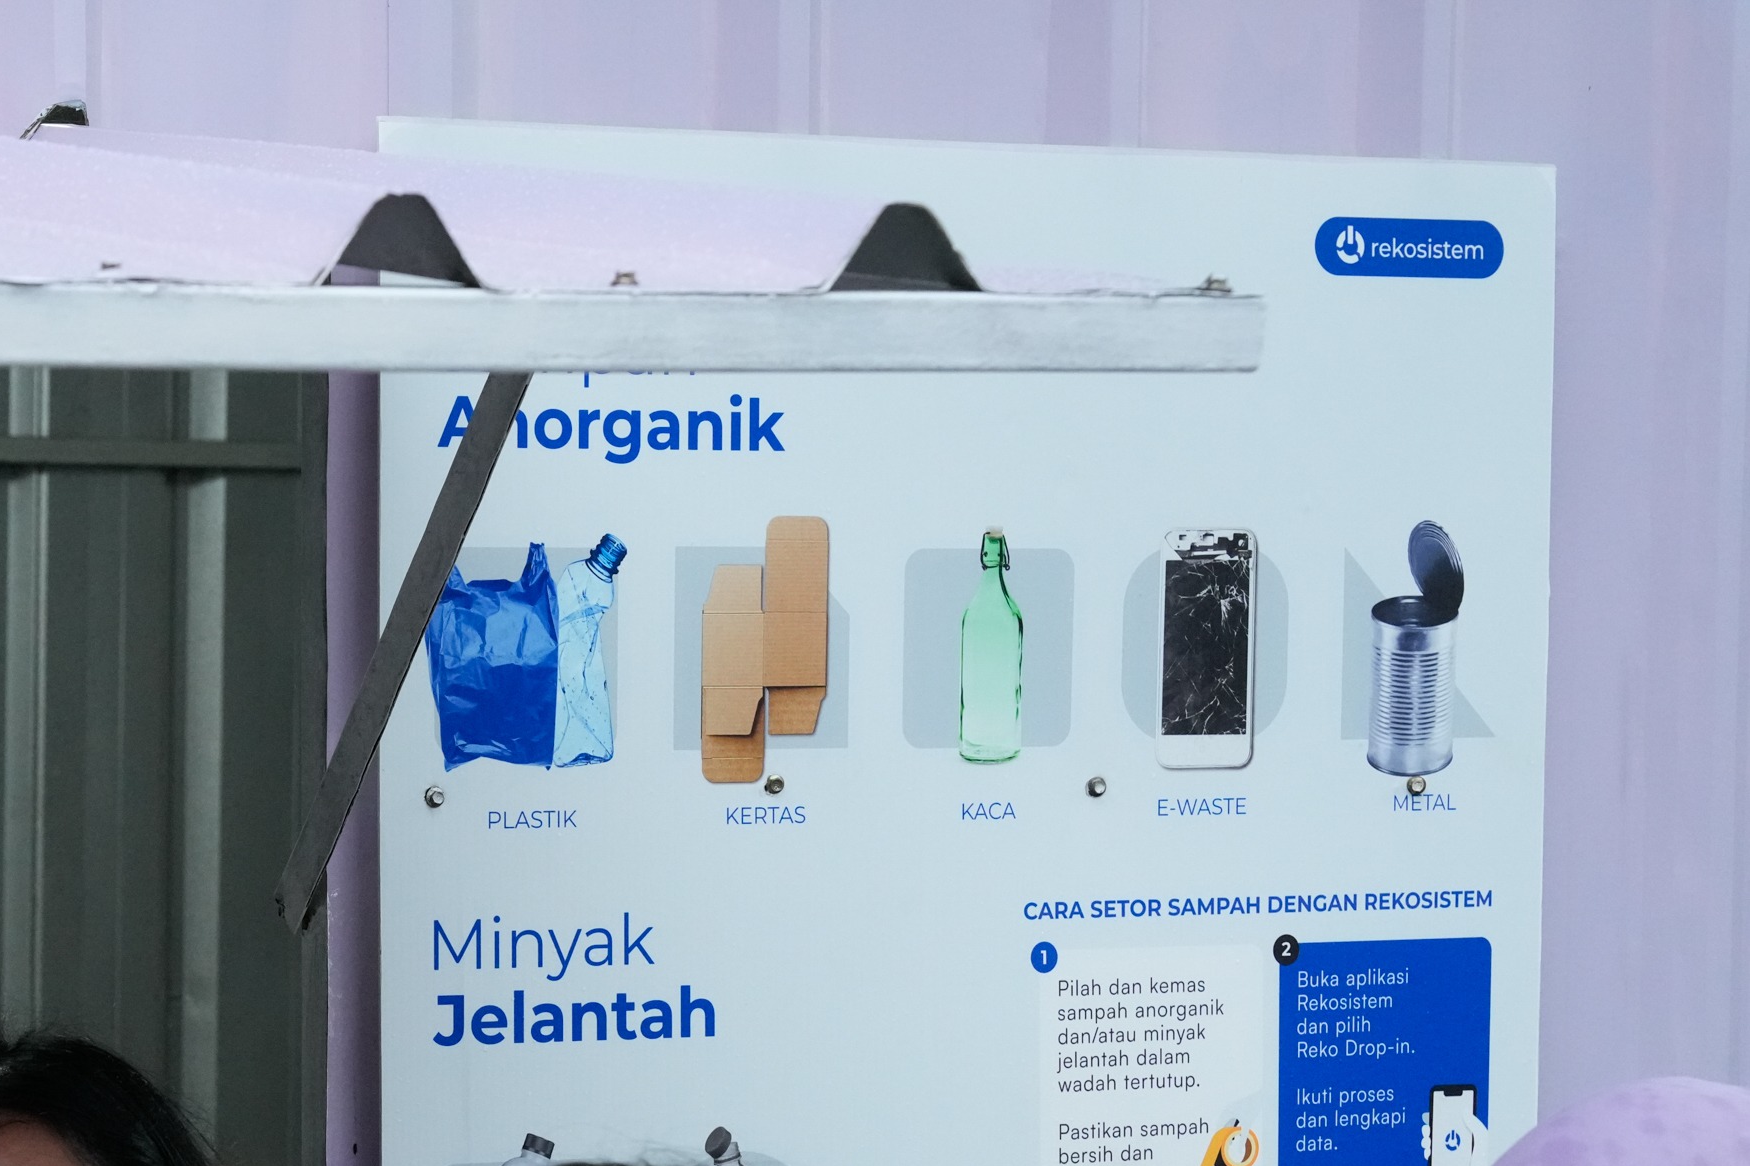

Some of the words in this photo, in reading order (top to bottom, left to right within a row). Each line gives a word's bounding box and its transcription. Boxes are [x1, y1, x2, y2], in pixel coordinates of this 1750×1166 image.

[1371, 237, 1484, 260] rekosistem
[962, 803, 1016, 820] KACA
[1158, 798, 1246, 816] E-WASTE
[1393, 793, 1457, 812] METAL
[489, 810, 576, 829] PLASTIK
[727, 806, 805, 824] KERTAS
[1024, 901, 1084, 920] CARA
[1091, 899, 1161, 918] SETOR
[1169, 897, 1260, 916] SAMPAH
[1268, 894, 1357, 913] DENGAN
[1365, 890, 1492, 910] REKOSISTEM
[432, 911, 656, 982] Minyak
[1282, 942, 1291, 956] 2
[1059, 979, 1101, 996] Pilah
[1109, 978, 1141, 995] dan
[1151, 977, 1205, 993] kemas
[1298, 970, 1338, 987] Buka
[1346, 968, 1408, 990] aplikasi
[1058, 1002, 1127, 1024] sampah
[1136, 999, 1223, 1021] anorganik
[1298, 993, 1392, 1011] Rekosistem
[432, 984, 716, 1047] Jelantah
[1058, 1027, 1135, 1045] dan/atau
[1145, 1023, 1205, 1045] minyak
[1297, 1018, 1328, 1035] dan
[1336, 1016, 1370, 1037] pilih
[1298, 1041, 1338, 1058] Reko
[1346, 1040, 1414, 1059] Drop-in.
[1057, 1050, 1128, 1073] jelantah
[1137, 1049, 1189, 1065] dalam
[1058, 1074, 1116, 1092] wadah
[1124, 1074, 1199, 1091] tertutup.
[1298, 1088, 1331, 1105] Ikuti
[1340, 1089, 1394, 1107] proses
[1296, 1112, 1327, 1128] dan
[1335, 1107, 1405, 1130] lengkapi
[1060, 1122, 1132, 1140] Pastikan
[1141, 1118, 1208, 1139] sampah
[1296, 1135, 1337, 1152] data.
[1059, 1146, 1112, 1164] bersih
[1121, 1145, 1152, 1161] dan
